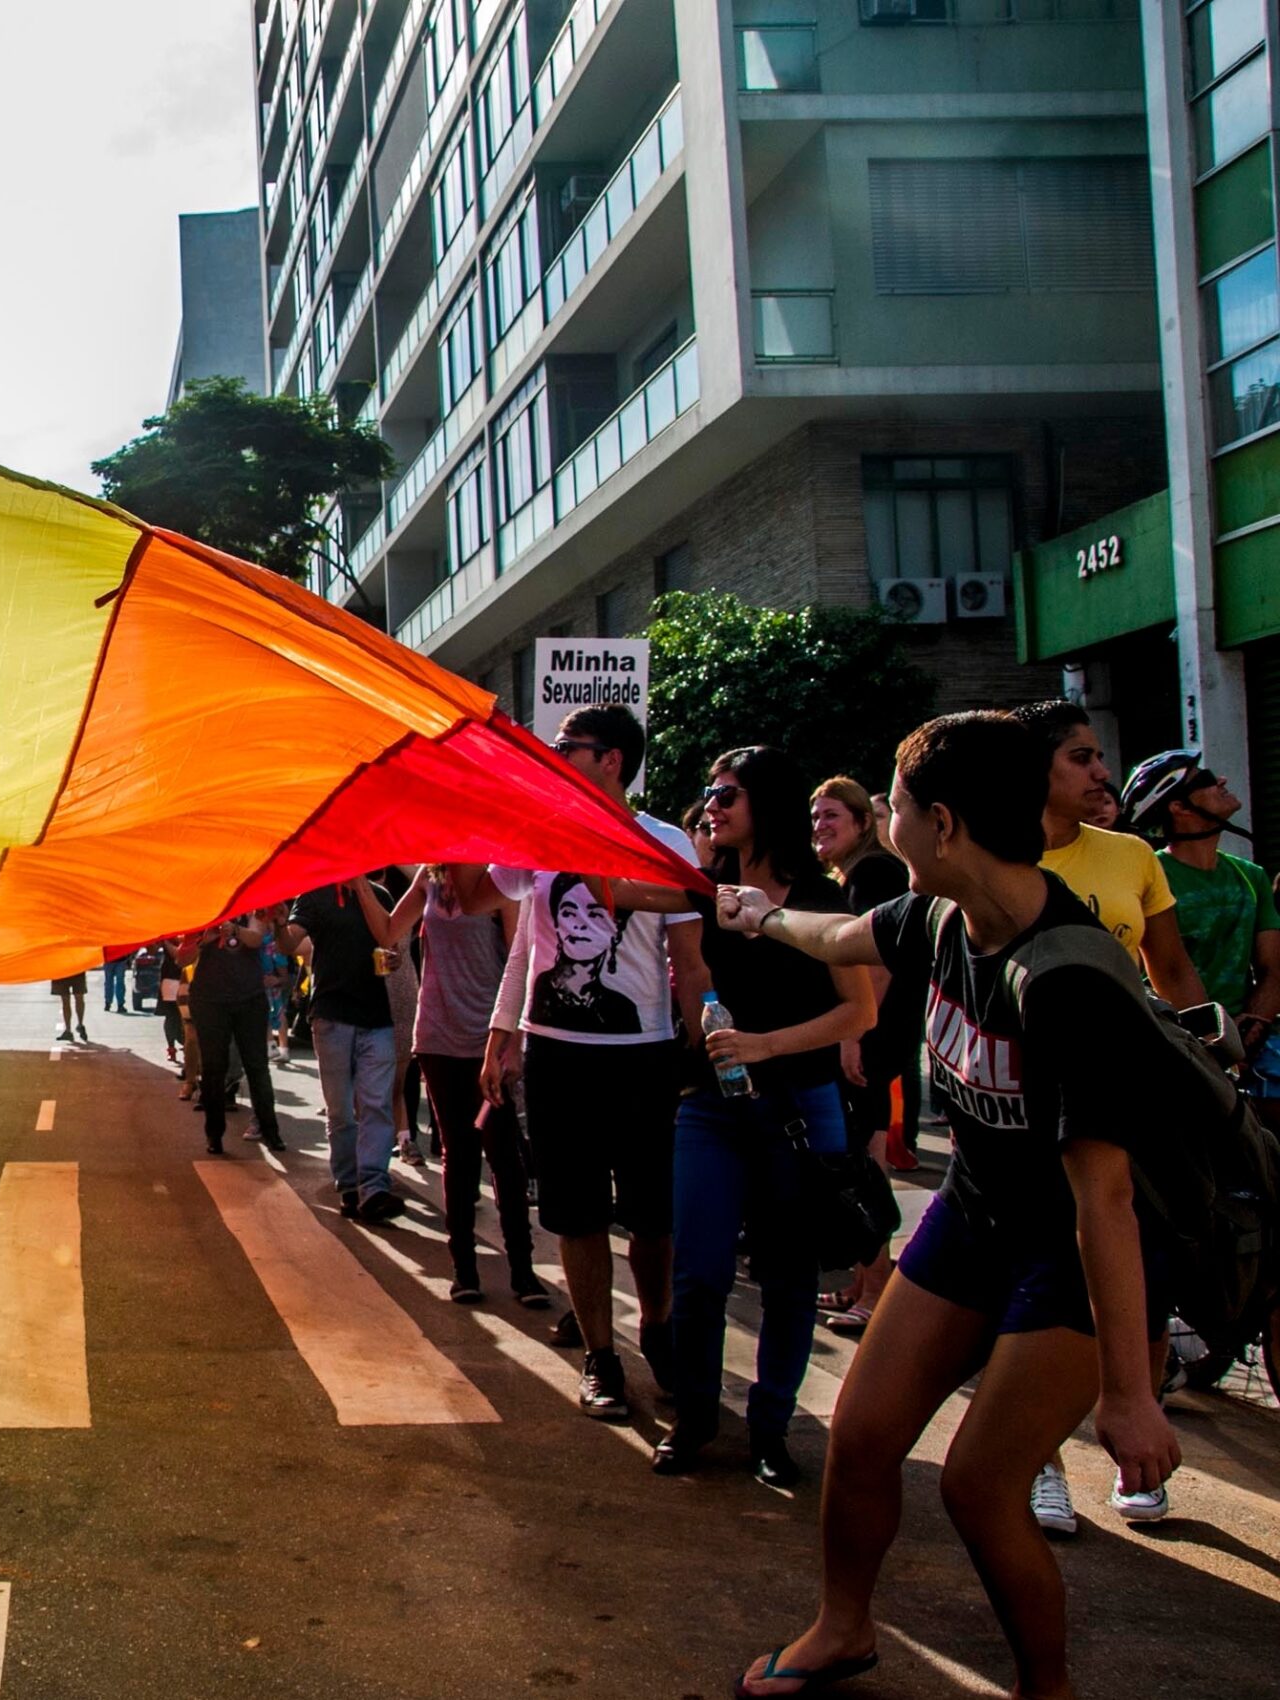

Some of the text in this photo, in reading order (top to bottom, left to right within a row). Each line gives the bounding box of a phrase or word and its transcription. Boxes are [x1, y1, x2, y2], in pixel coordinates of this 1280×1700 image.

[1076, 535, 1121, 579] 2452
[551, 649, 635, 672] Minha
[542, 675, 640, 705] Sexualidade
